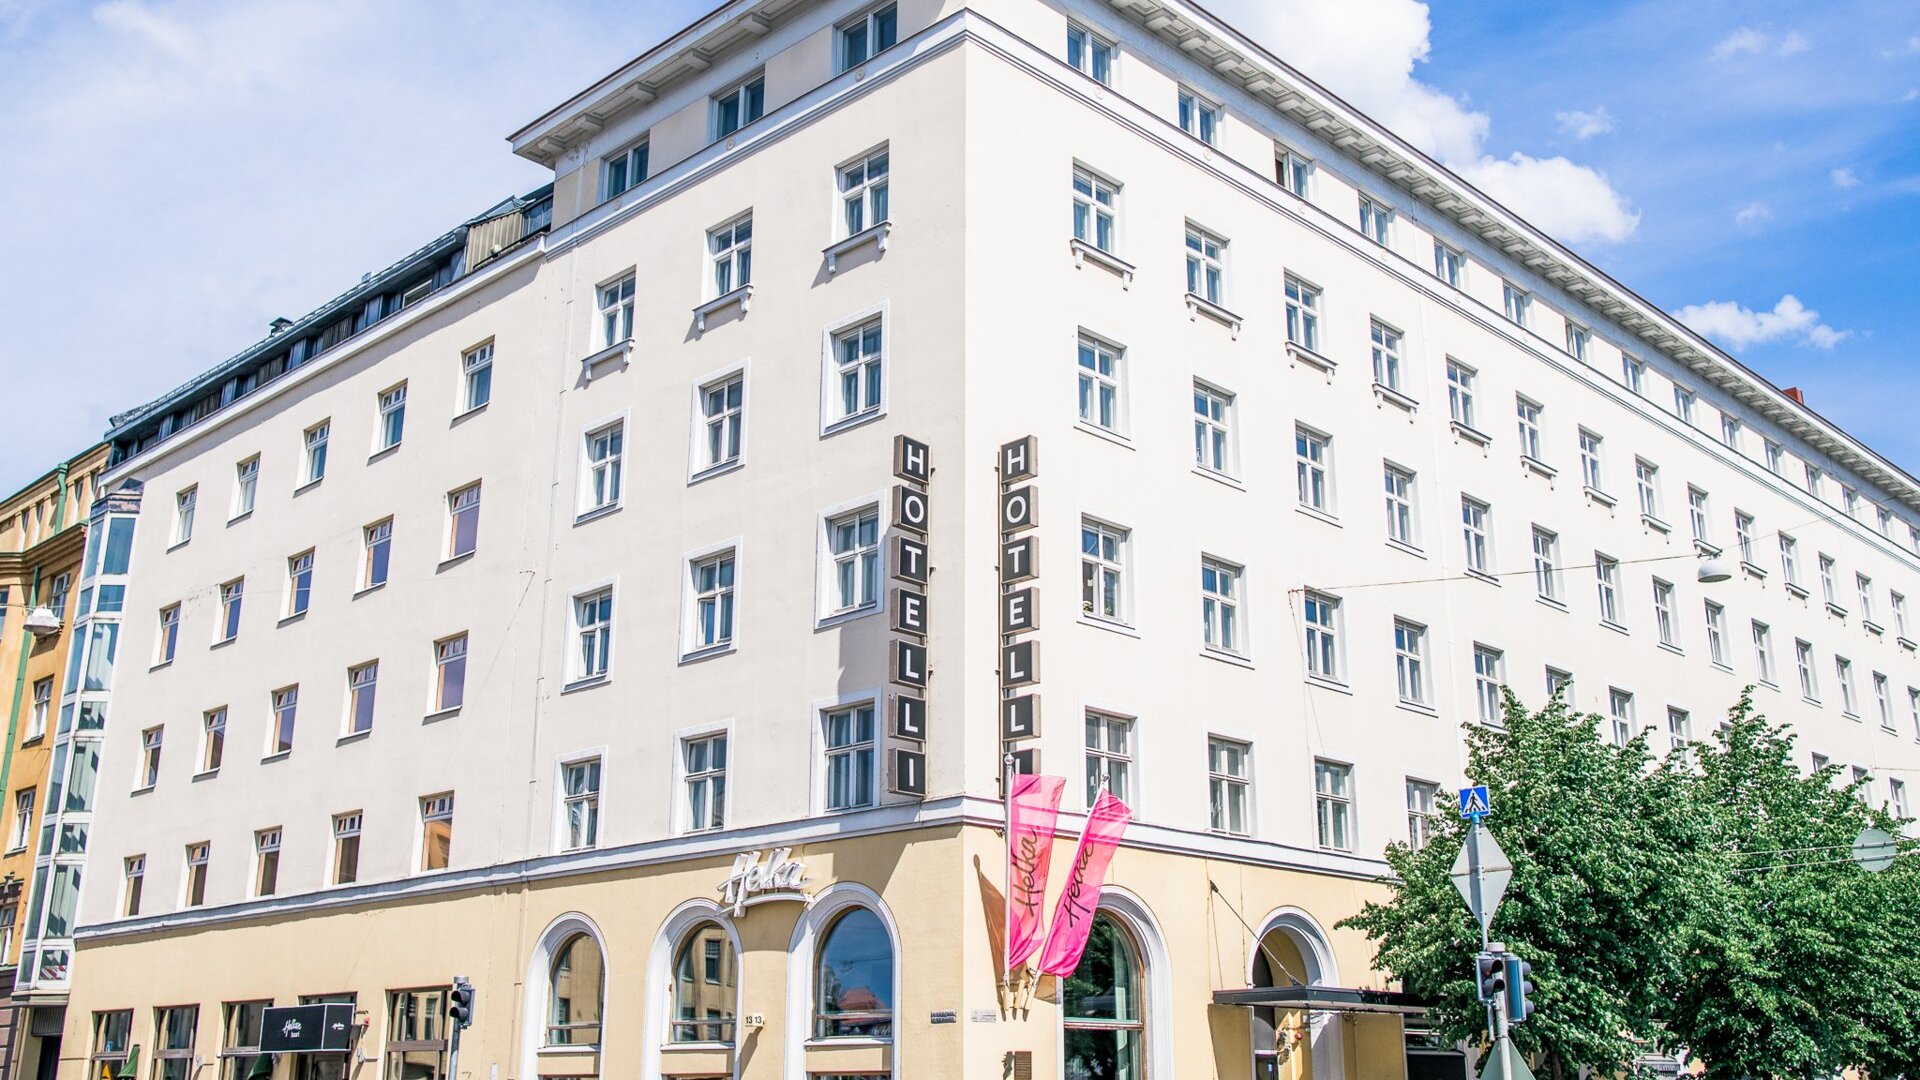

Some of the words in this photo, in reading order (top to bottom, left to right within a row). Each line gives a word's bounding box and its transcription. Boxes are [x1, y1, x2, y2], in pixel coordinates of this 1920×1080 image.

[904, 443, 924, 787] HOTELLI
[1006, 444, 1027, 786] HOTELLI
[716, 847, 808, 918] Helka
[1011, 828, 1043, 917] Helka
[1063, 840, 1095, 928] Helka
[745, 1015, 753, 1024] 13
[754, 1015, 762, 1024] 13
